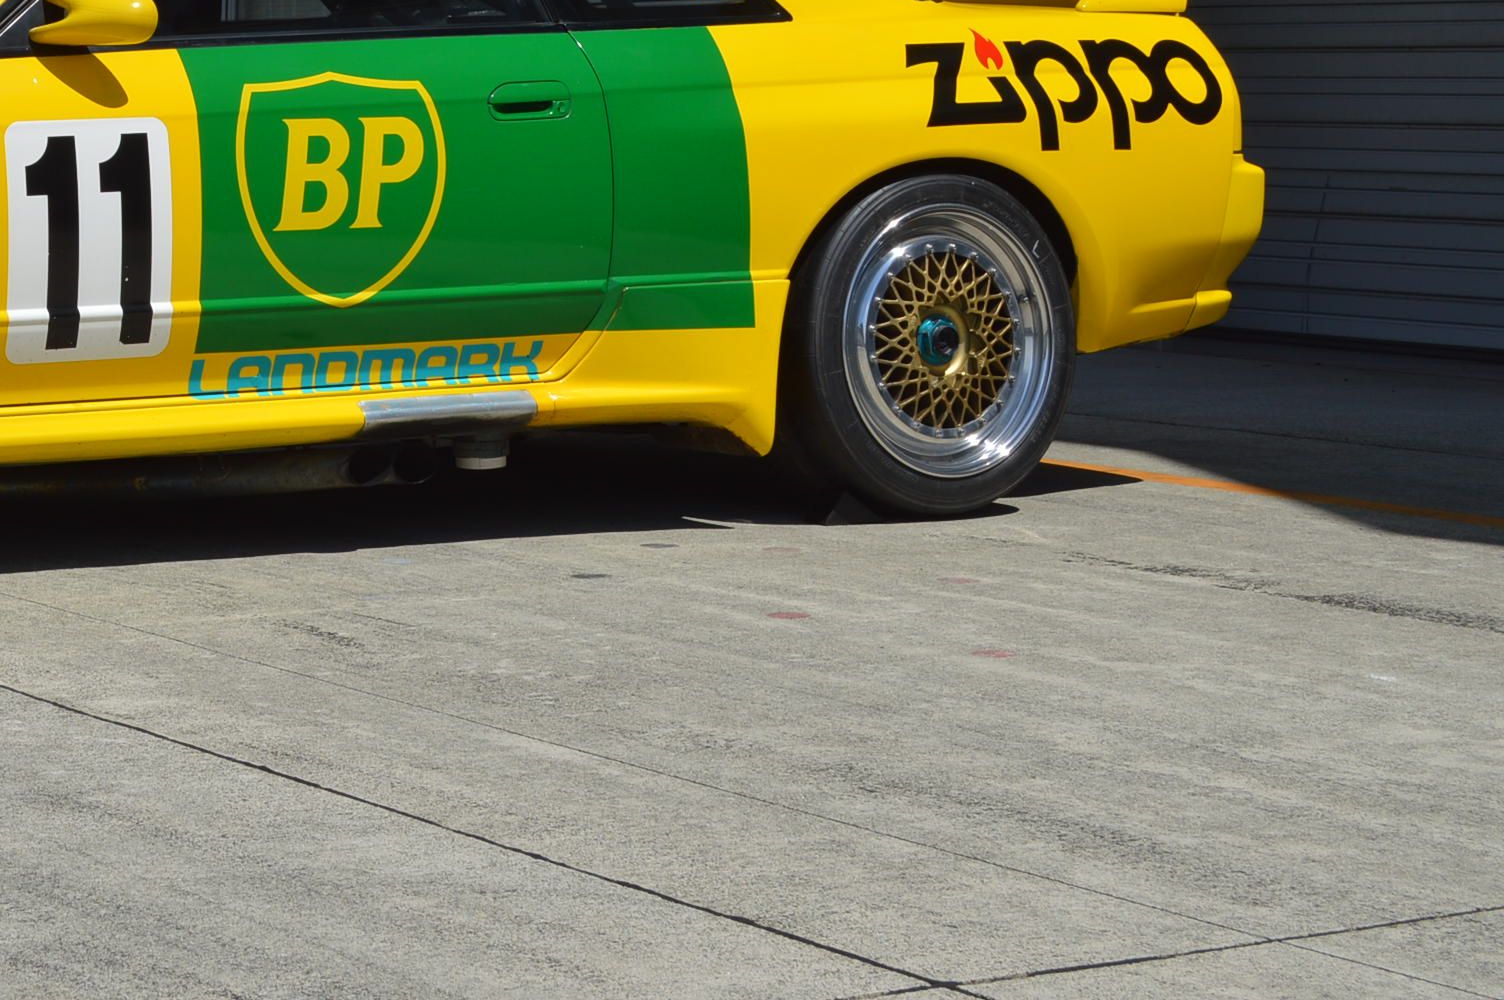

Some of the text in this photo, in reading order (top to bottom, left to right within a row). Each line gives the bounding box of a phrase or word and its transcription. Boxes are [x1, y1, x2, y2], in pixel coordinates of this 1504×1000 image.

[272, 116, 425, 232] BP
[25, 132, 154, 350] 11
[187, 340, 544, 401] LANDMARK
